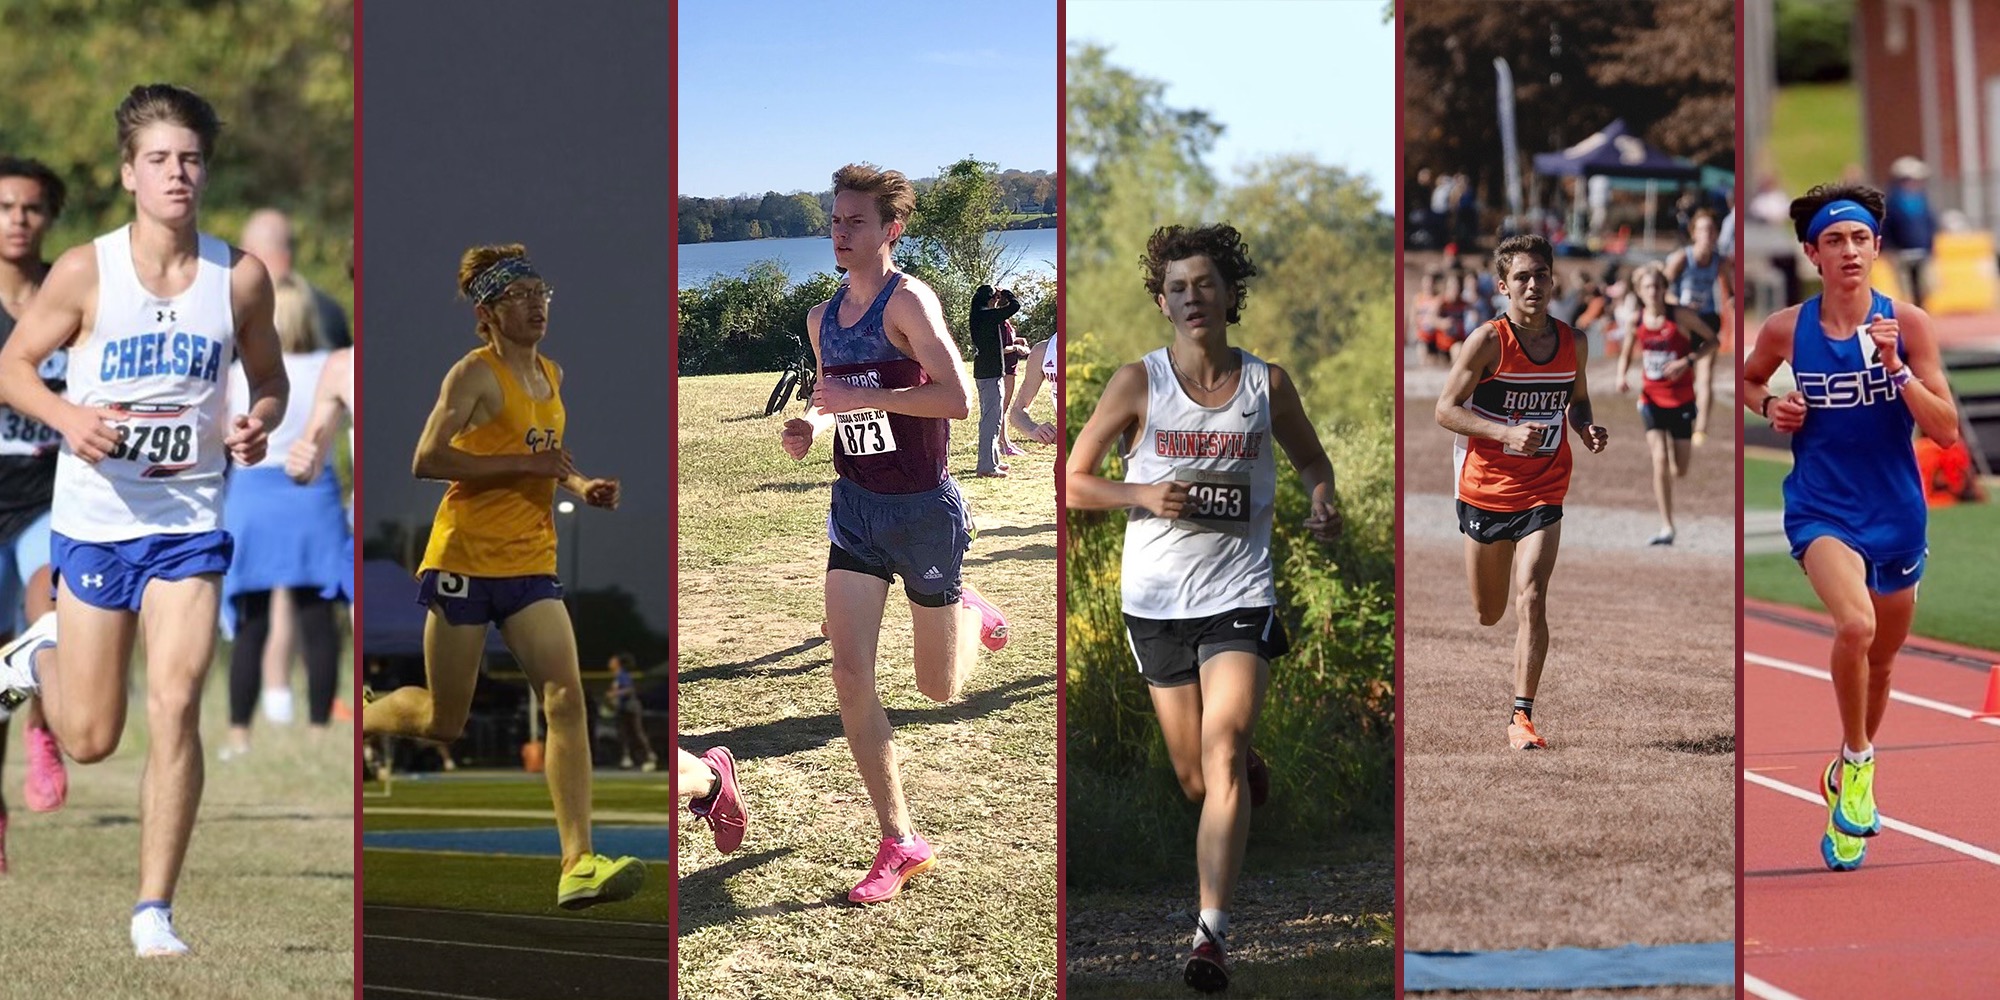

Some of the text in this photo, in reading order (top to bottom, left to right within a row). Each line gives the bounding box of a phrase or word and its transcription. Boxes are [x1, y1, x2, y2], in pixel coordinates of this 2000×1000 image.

[100, 332, 222, 382] CHELSEA
[1503, 390, 1568, 410] HOOVER
[1797, 371, 1897, 407] CSH
[853, 412, 873, 423] STATE
[874, 409, 884, 420] XC
[844, 422, 885, 454] 873
[1155, 430, 1263, 459] GAINESVILLE
